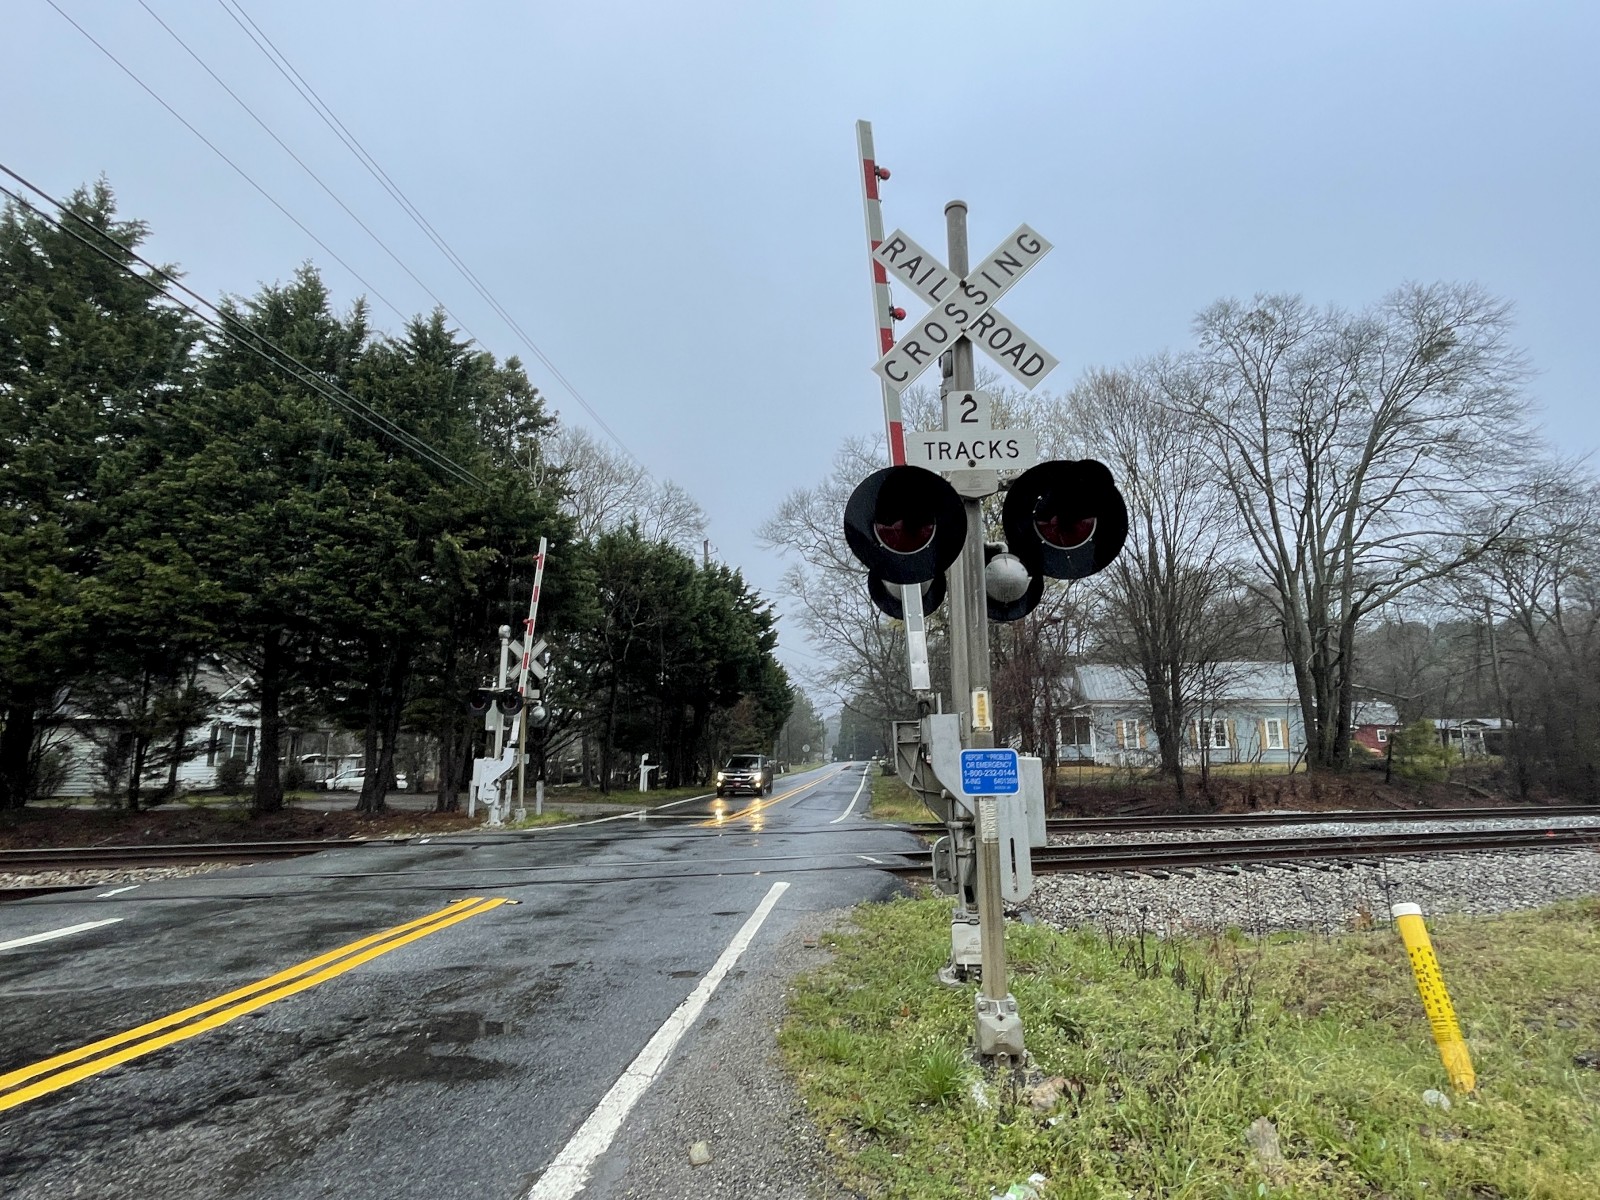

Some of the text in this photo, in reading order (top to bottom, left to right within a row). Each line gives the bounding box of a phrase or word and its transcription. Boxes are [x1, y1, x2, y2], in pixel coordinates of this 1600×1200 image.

[884, 232, 1042, 383] CROSSING
[960, 397, 979, 423] 2
[923, 439, 1020, 461] TRACKS
[965, 753, 1012, 761] REPORT PROBLEM
[965, 761, 1012, 769] OR EMERGENCY
[964, 769, 1016, 777] 1-800-232-0144
[1417, 947, 1443, 1013] PIPELINE
